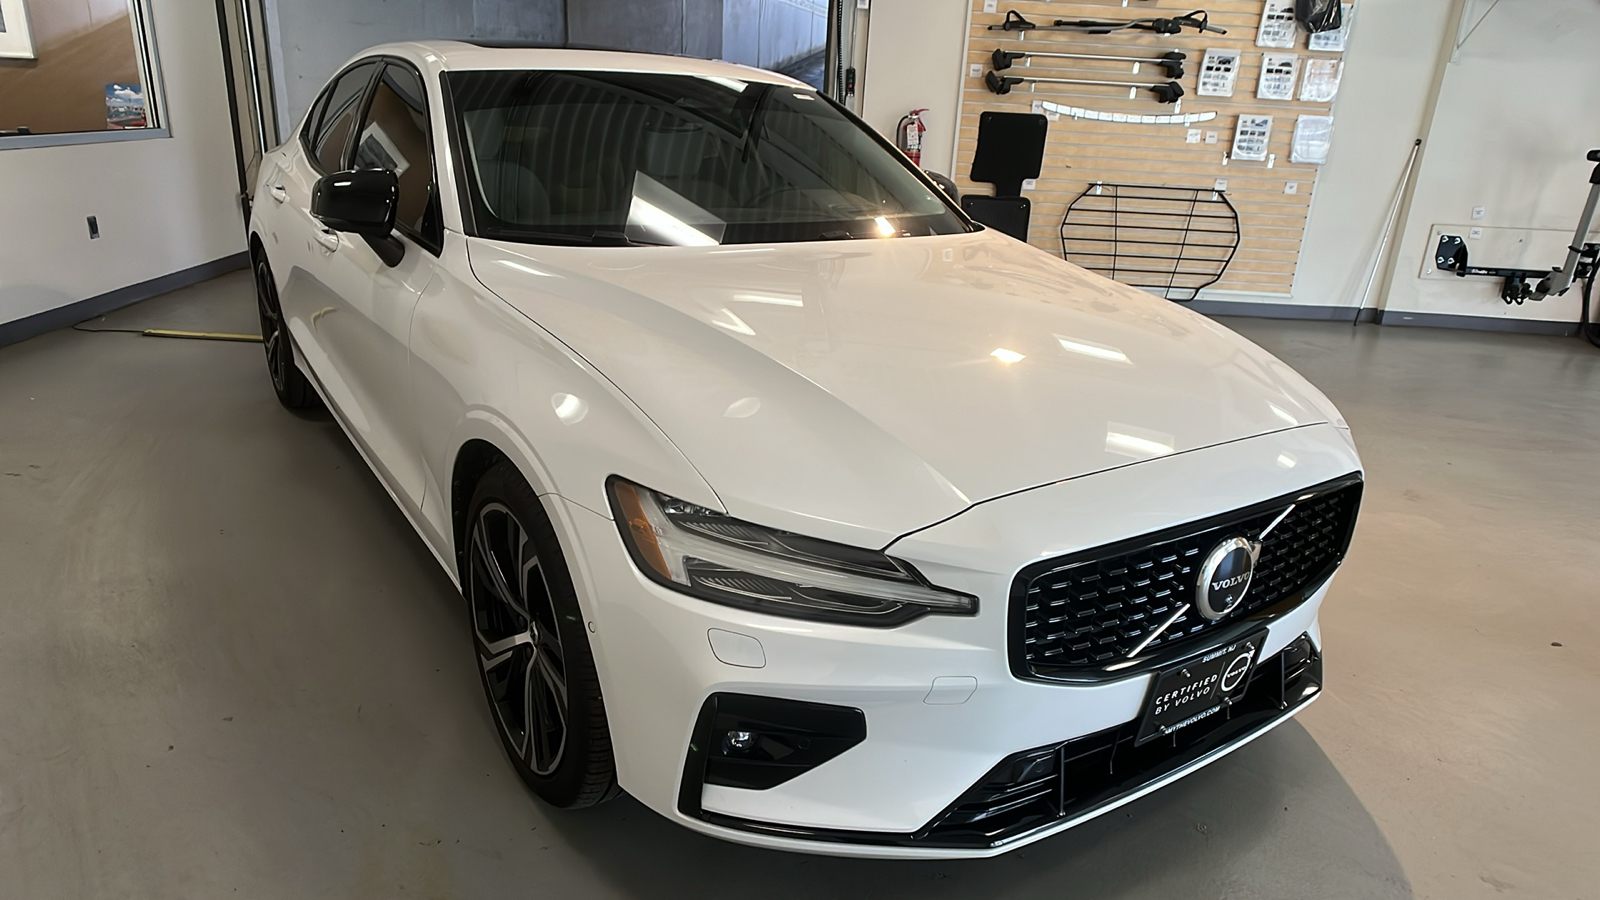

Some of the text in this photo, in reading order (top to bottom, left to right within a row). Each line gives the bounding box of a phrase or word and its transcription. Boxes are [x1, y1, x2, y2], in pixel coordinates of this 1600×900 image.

[1212, 572, 1249, 591] VOLVO
[1155, 686, 1210, 715] BY VOLVO
[1156, 674, 1218, 705] CERTIFIED
